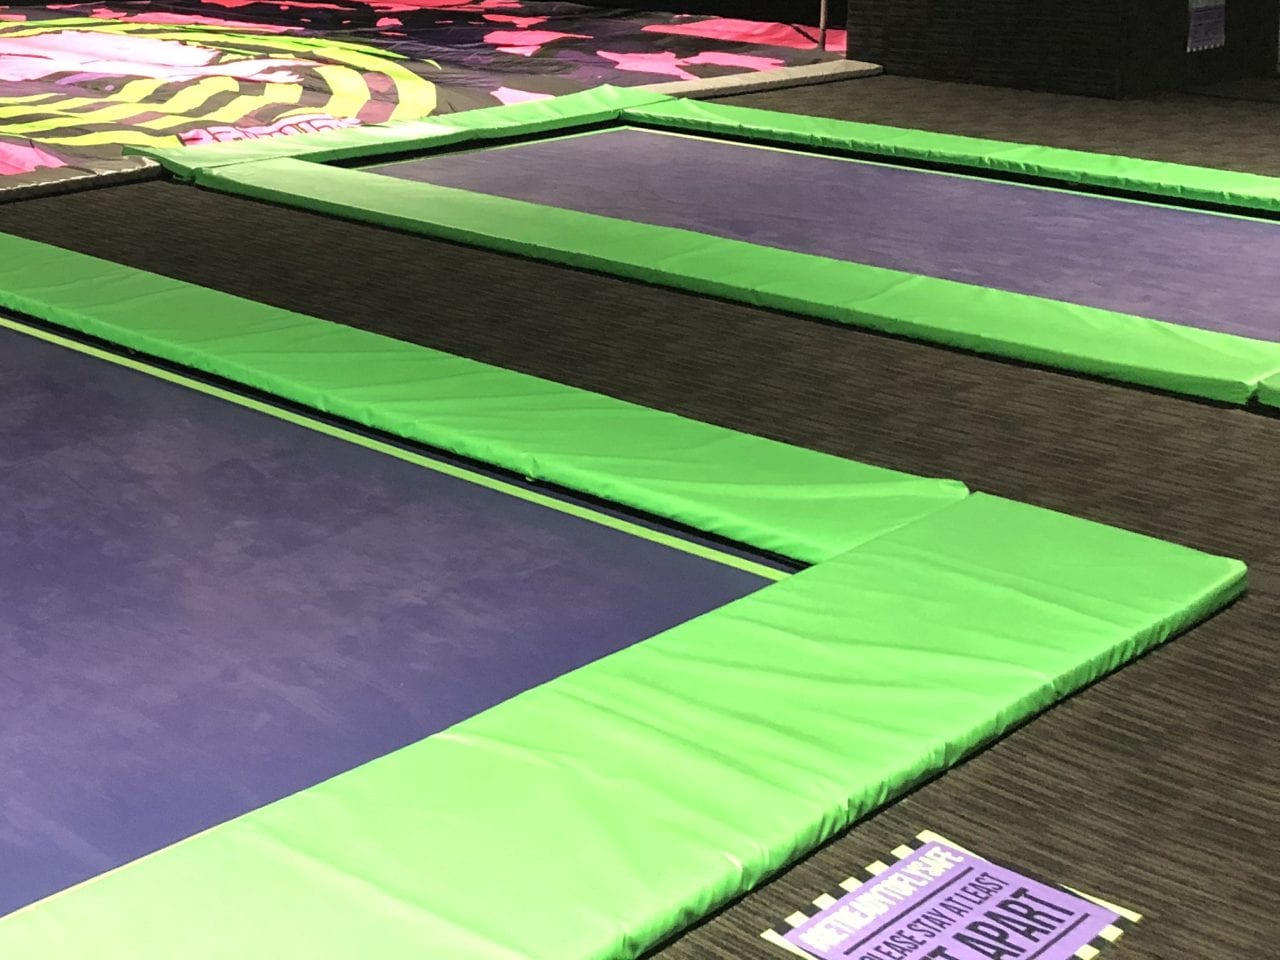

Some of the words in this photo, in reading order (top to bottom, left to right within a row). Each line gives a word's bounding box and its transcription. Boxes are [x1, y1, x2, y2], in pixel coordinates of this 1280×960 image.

[954, 871, 1009, 905] LEAST
[907, 907, 957, 938] STAY
[939, 896, 974, 918] AT
[951, 886, 1076, 960] APART
